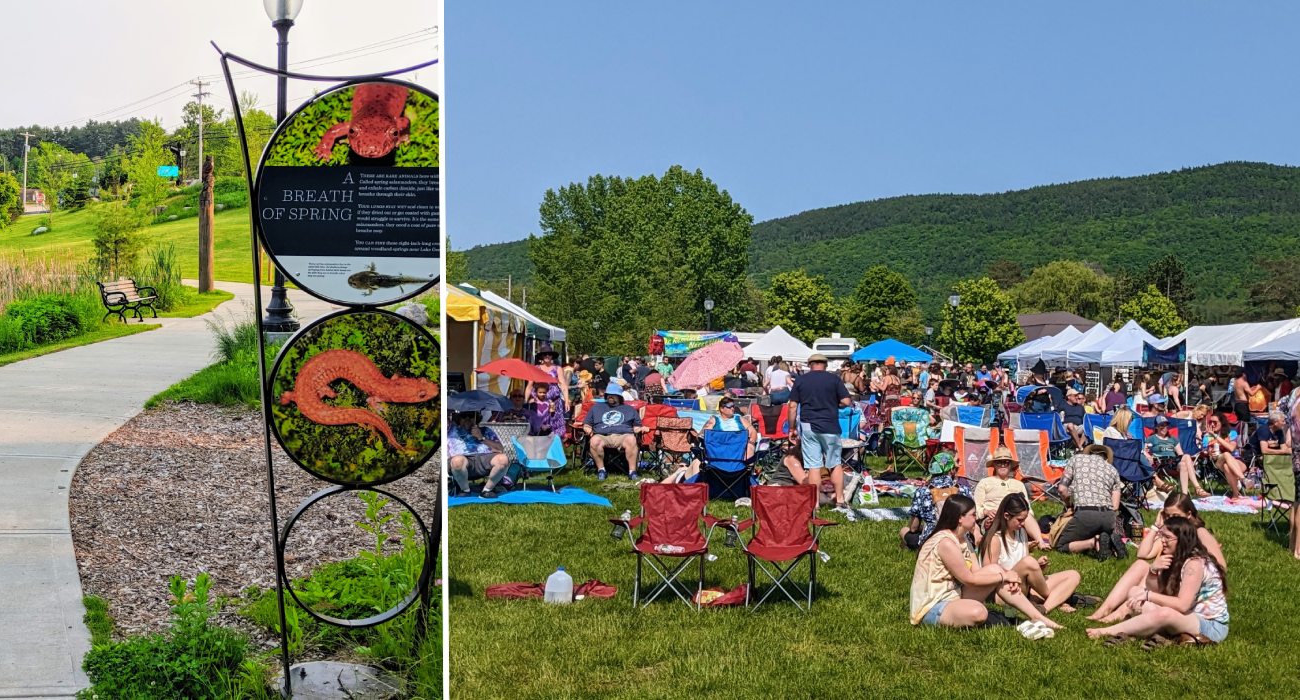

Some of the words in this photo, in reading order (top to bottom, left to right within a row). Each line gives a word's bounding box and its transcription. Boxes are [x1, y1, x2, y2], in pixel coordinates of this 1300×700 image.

[341, 171, 355, 184] A
[282, 189, 354, 203] BREATH
[262, 207, 285, 220] OF
[288, 207, 353, 221] SPRING
